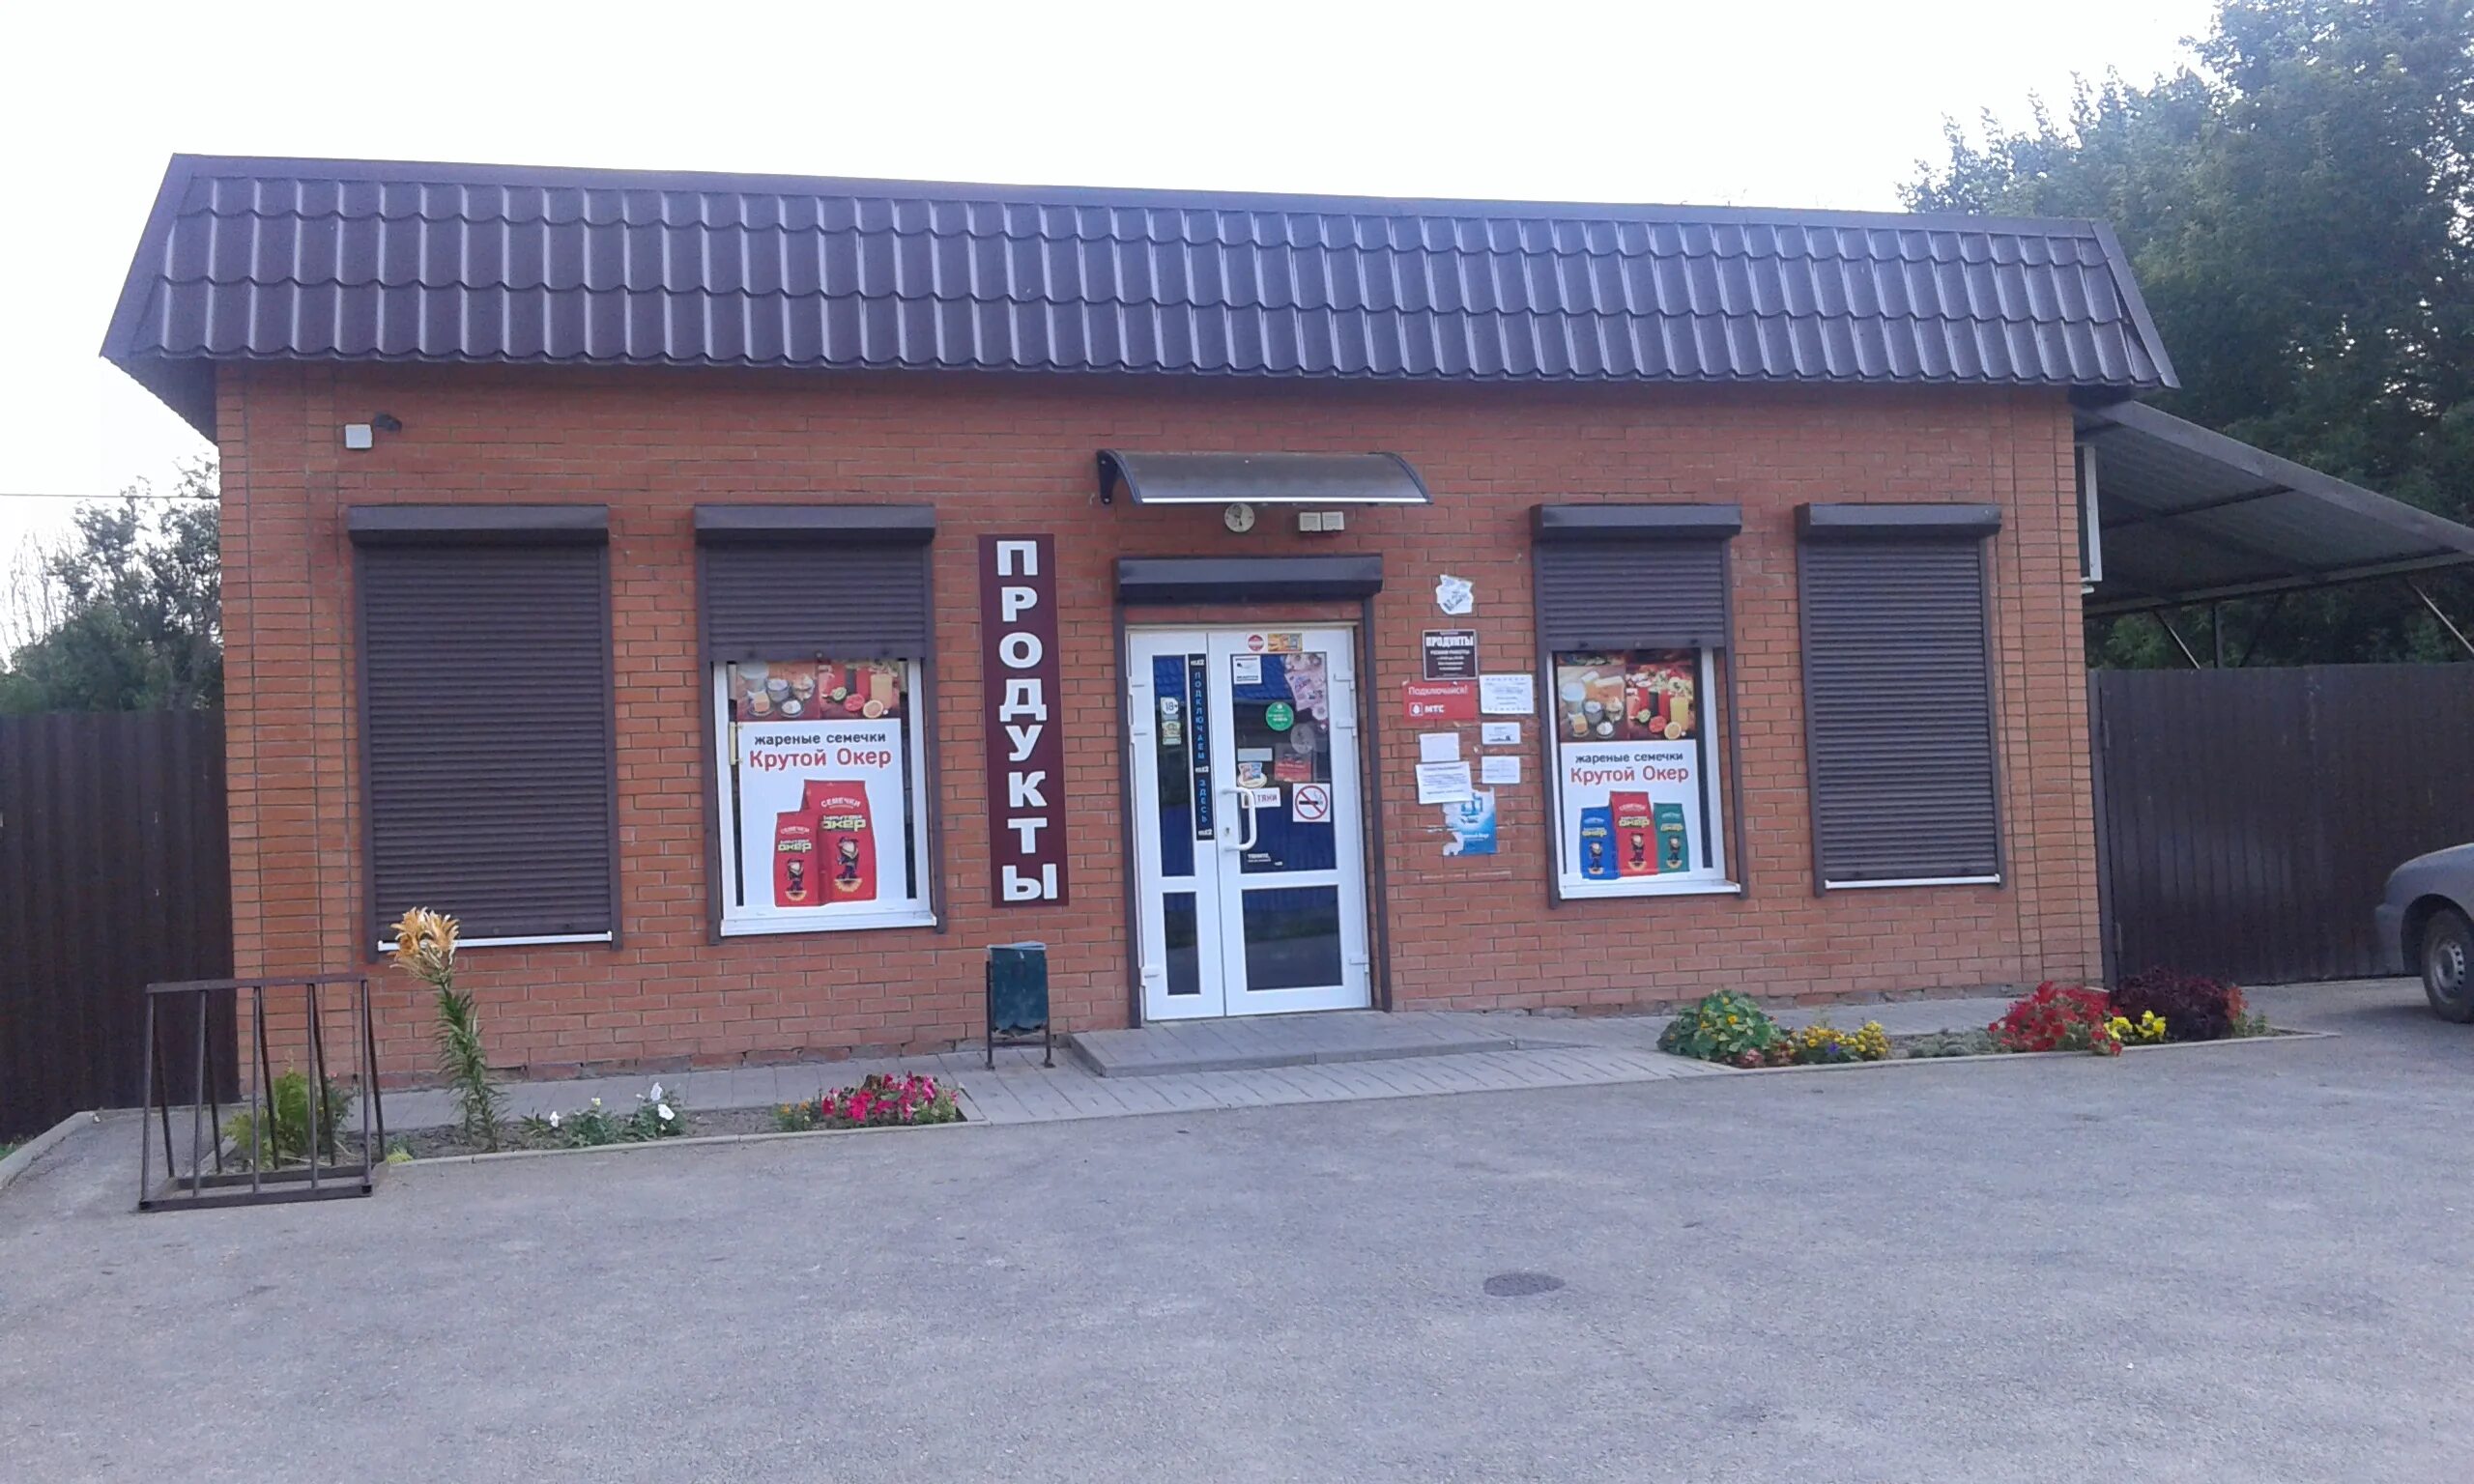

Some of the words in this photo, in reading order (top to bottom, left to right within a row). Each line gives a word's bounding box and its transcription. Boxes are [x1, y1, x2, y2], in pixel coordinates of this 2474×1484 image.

[1194, 671, 1205, 759] ПОДКЛЮЧАЕМ
[1424, 704, 1446, 713] МТС
[995, 539, 1058, 901] ПРОДУКТЫ
[754, 732, 820, 746] жареные
[826, 731, 886, 744] семечки
[749, 748, 827, 771] Крутой
[837, 747, 892, 768] Окер
[1574, 753, 1630, 764] жареные
[1633, 752, 1683, 762] семечки
[1570, 765, 1635, 785] Крутой
[1642, 765, 1689, 784] Окер
[820, 797, 861, 808] СЕМЕЧКИ
[1198, 779, 1208, 823] ЗДЕСЬ
